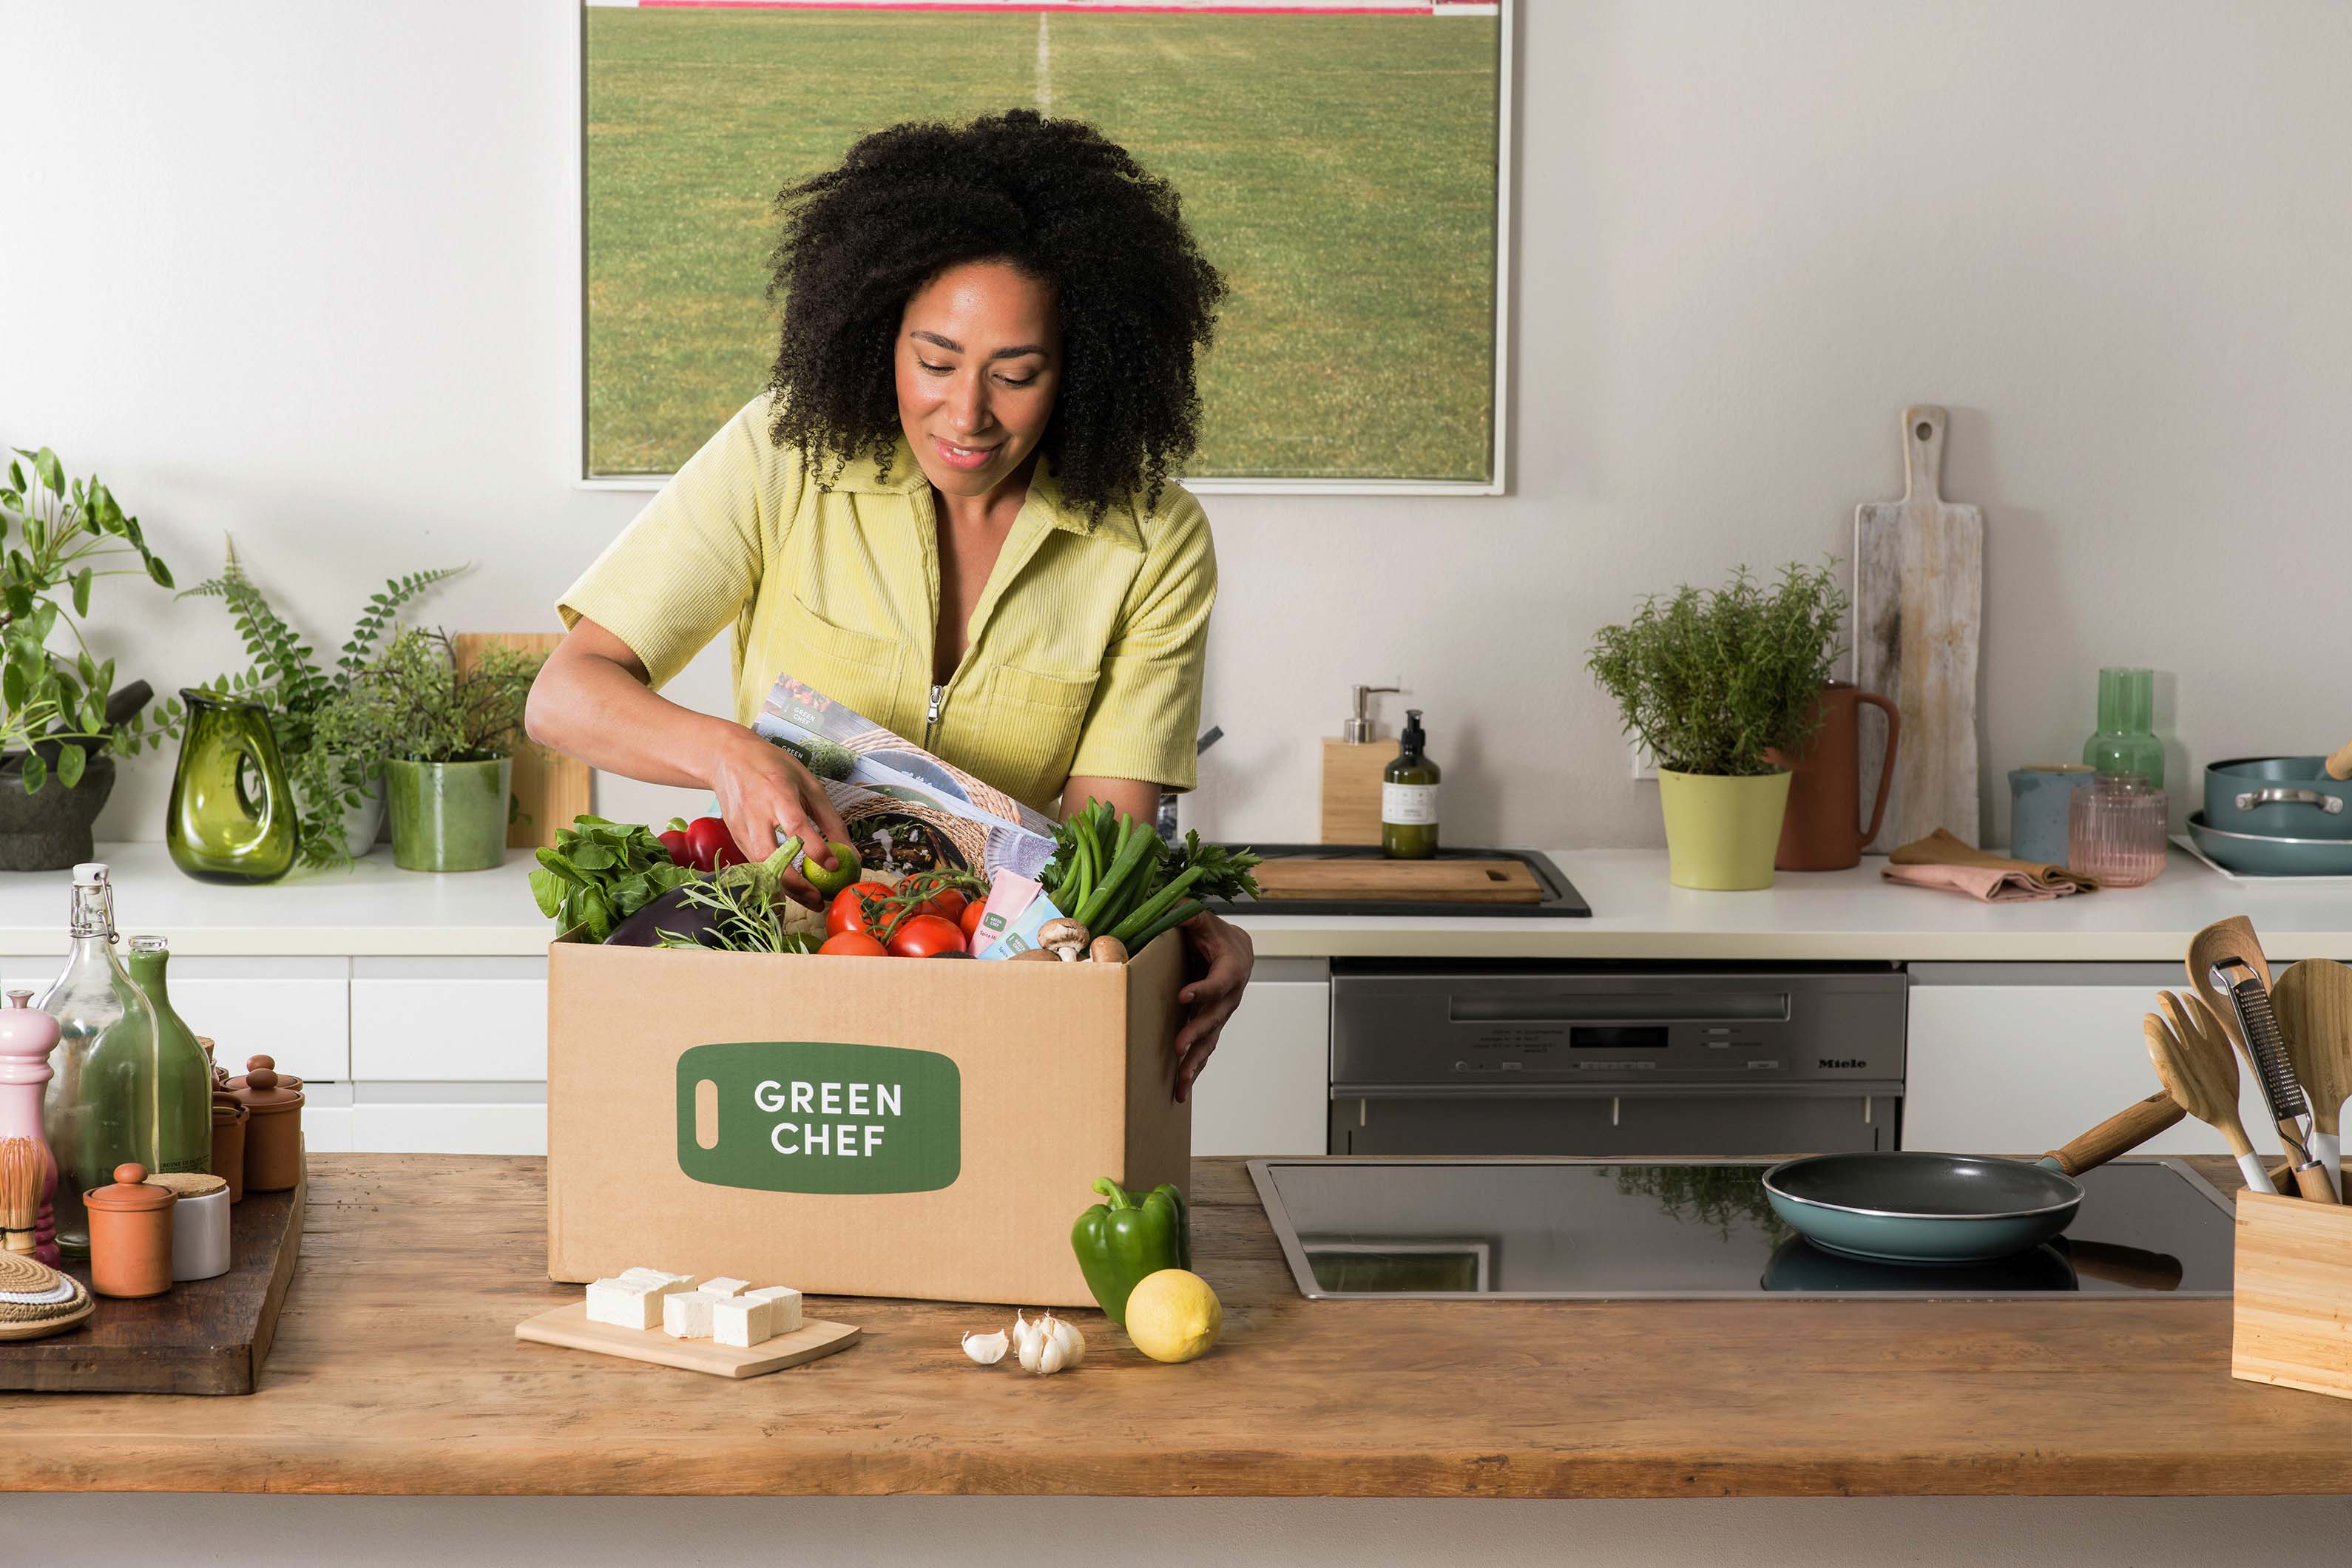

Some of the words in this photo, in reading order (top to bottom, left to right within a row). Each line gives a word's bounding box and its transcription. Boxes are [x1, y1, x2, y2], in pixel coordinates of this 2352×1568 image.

[793, 714, 811, 726] CHEF
[794, 707, 816, 722] GREEN
[1818, 1058, 1867, 1069] Miele
[754, 1080, 901, 1116] GREEN
[771, 1122, 885, 1157] CHEF
